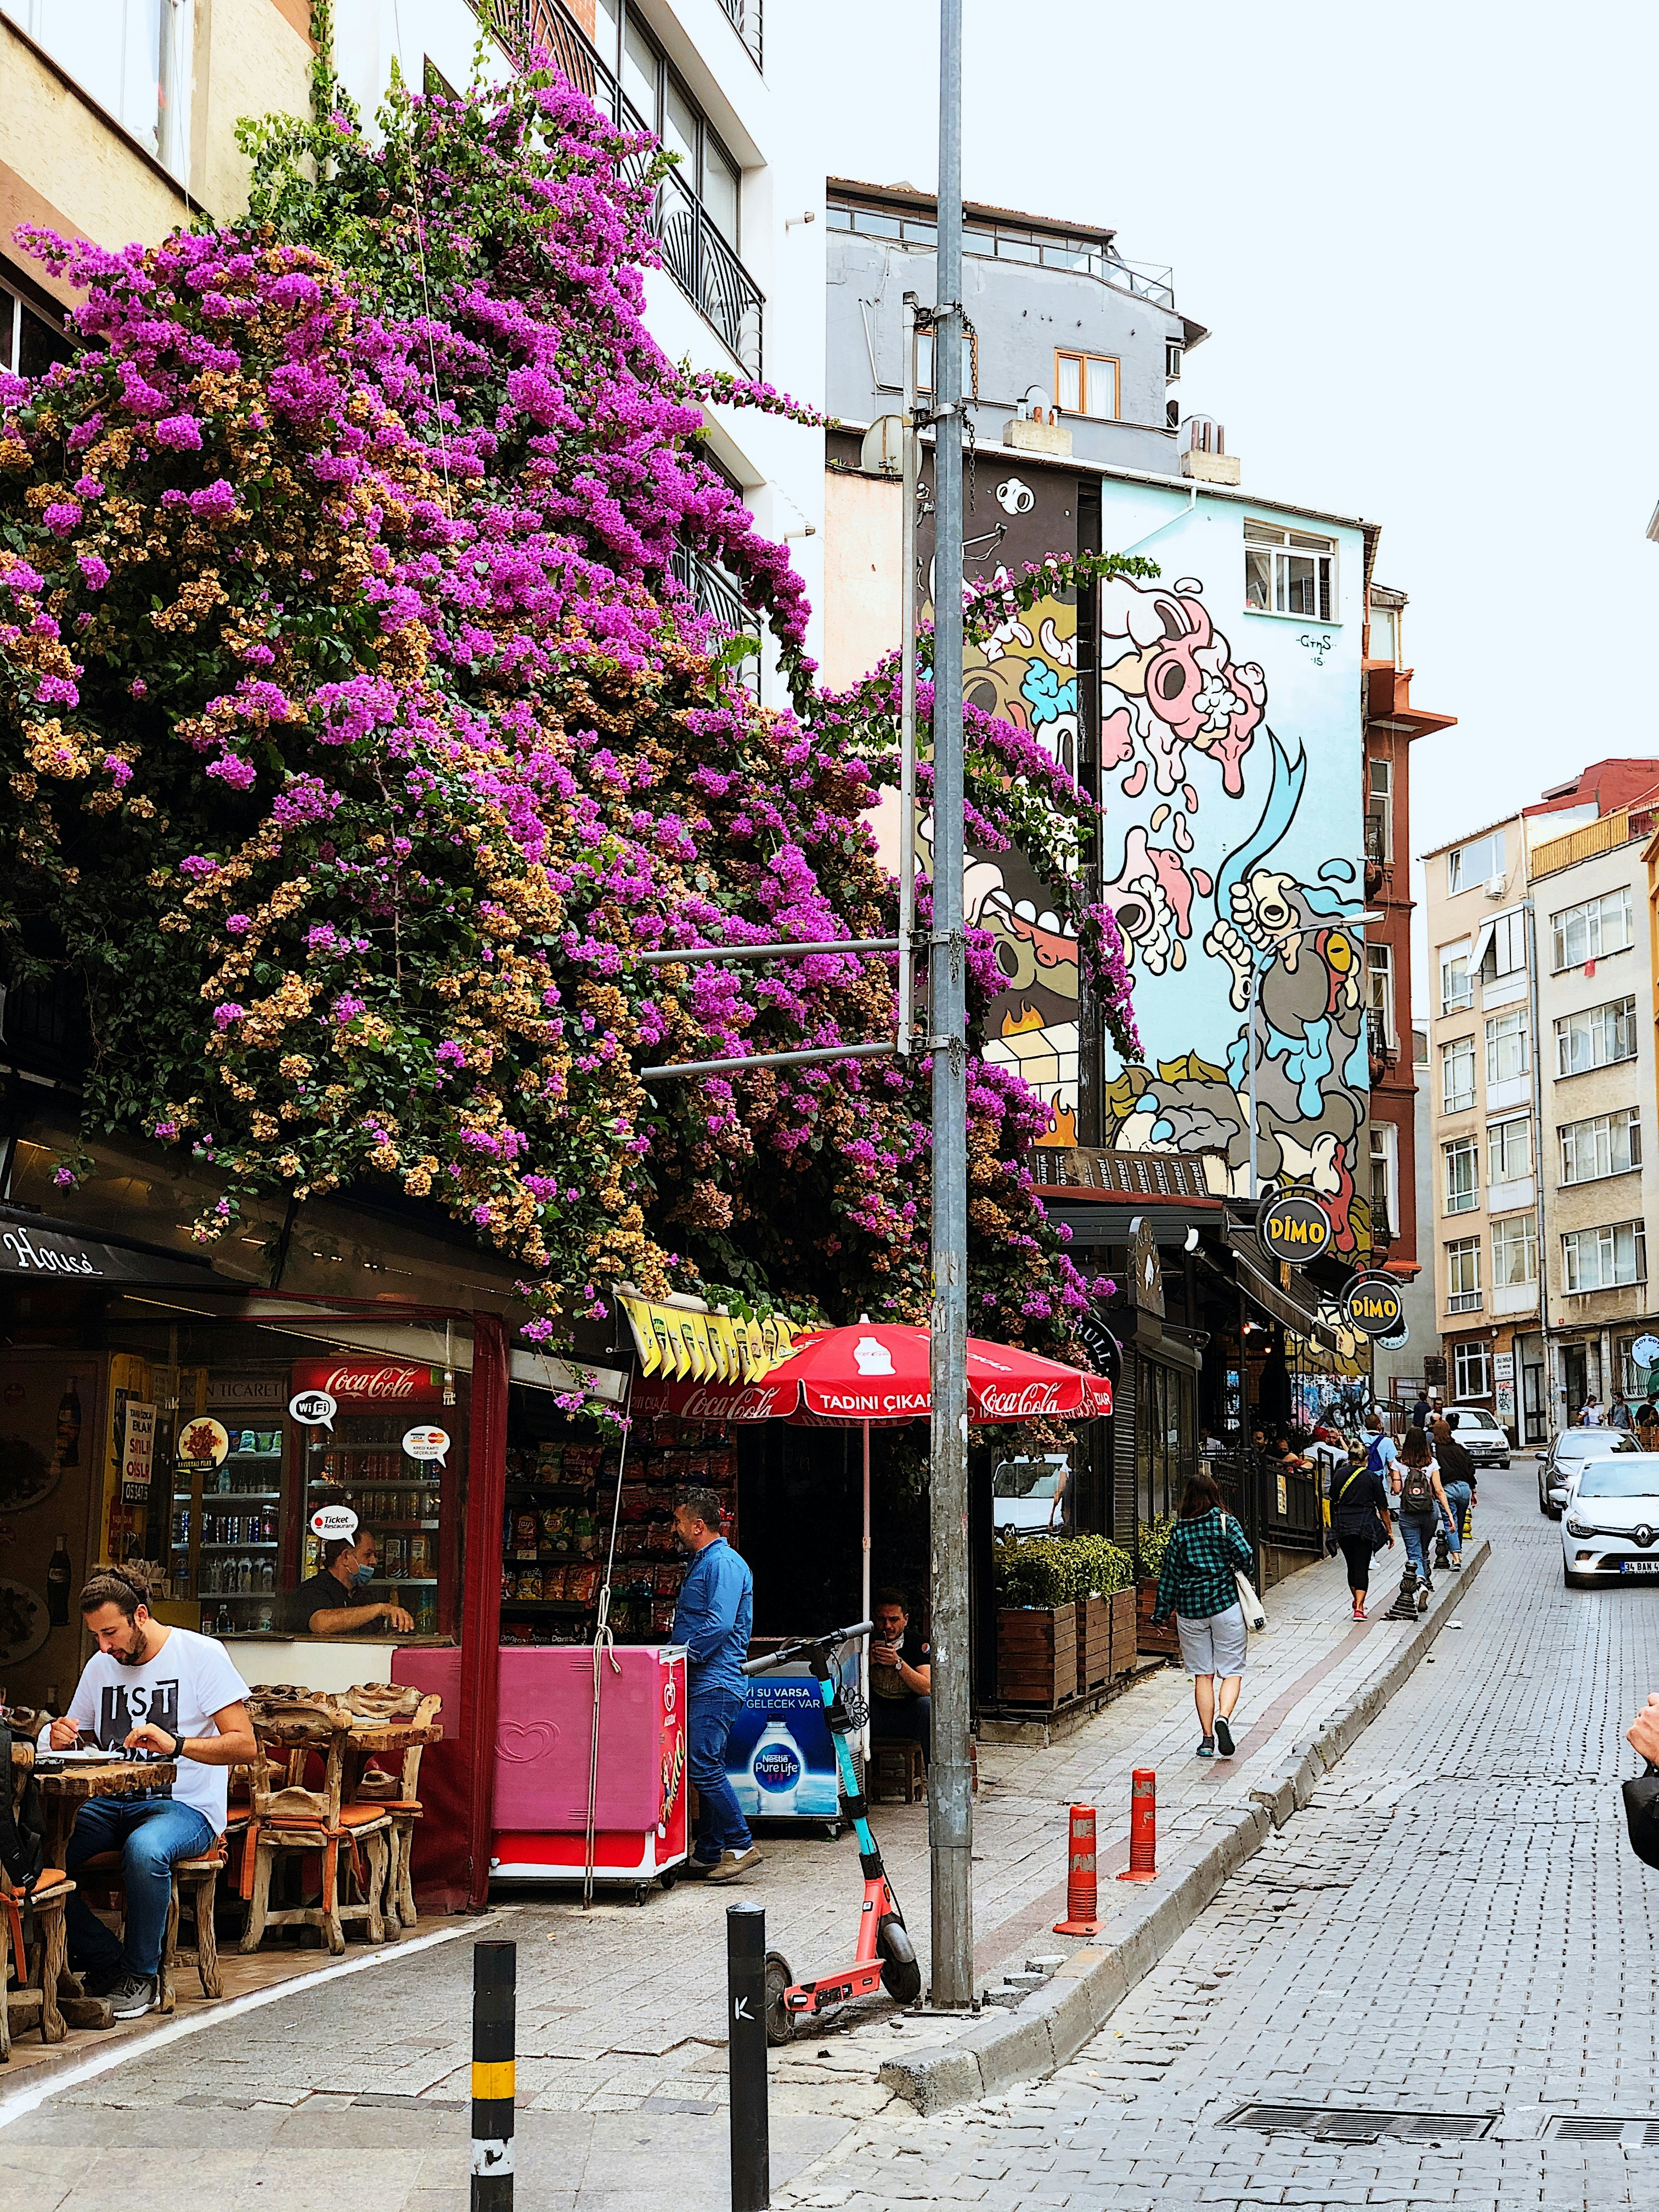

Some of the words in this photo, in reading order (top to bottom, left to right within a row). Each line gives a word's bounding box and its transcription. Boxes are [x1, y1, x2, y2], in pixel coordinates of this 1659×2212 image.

[1314, 657, 1323, 666] 15
[1170, 1161, 1186, 1196] winroof
[1189, 1162, 1205, 1197] winroof
[325, 1367, 416, 1398] Coca-Cola
[681, 1387, 781, 1419] Coca-Cola
[820, 1394, 878, 1410] TADINI
[981, 1383, 1063, 1415] Coca-Cola
[746, 1699, 795, 1708] GELECEK
[798, 1699, 820, 1708] VAR
[757, 1688, 771, 1697] SU
[774, 1688, 810, 1697] VARSA
[755, 1762, 780, 1773] Pure
[781, 1762, 798, 1776] Life
